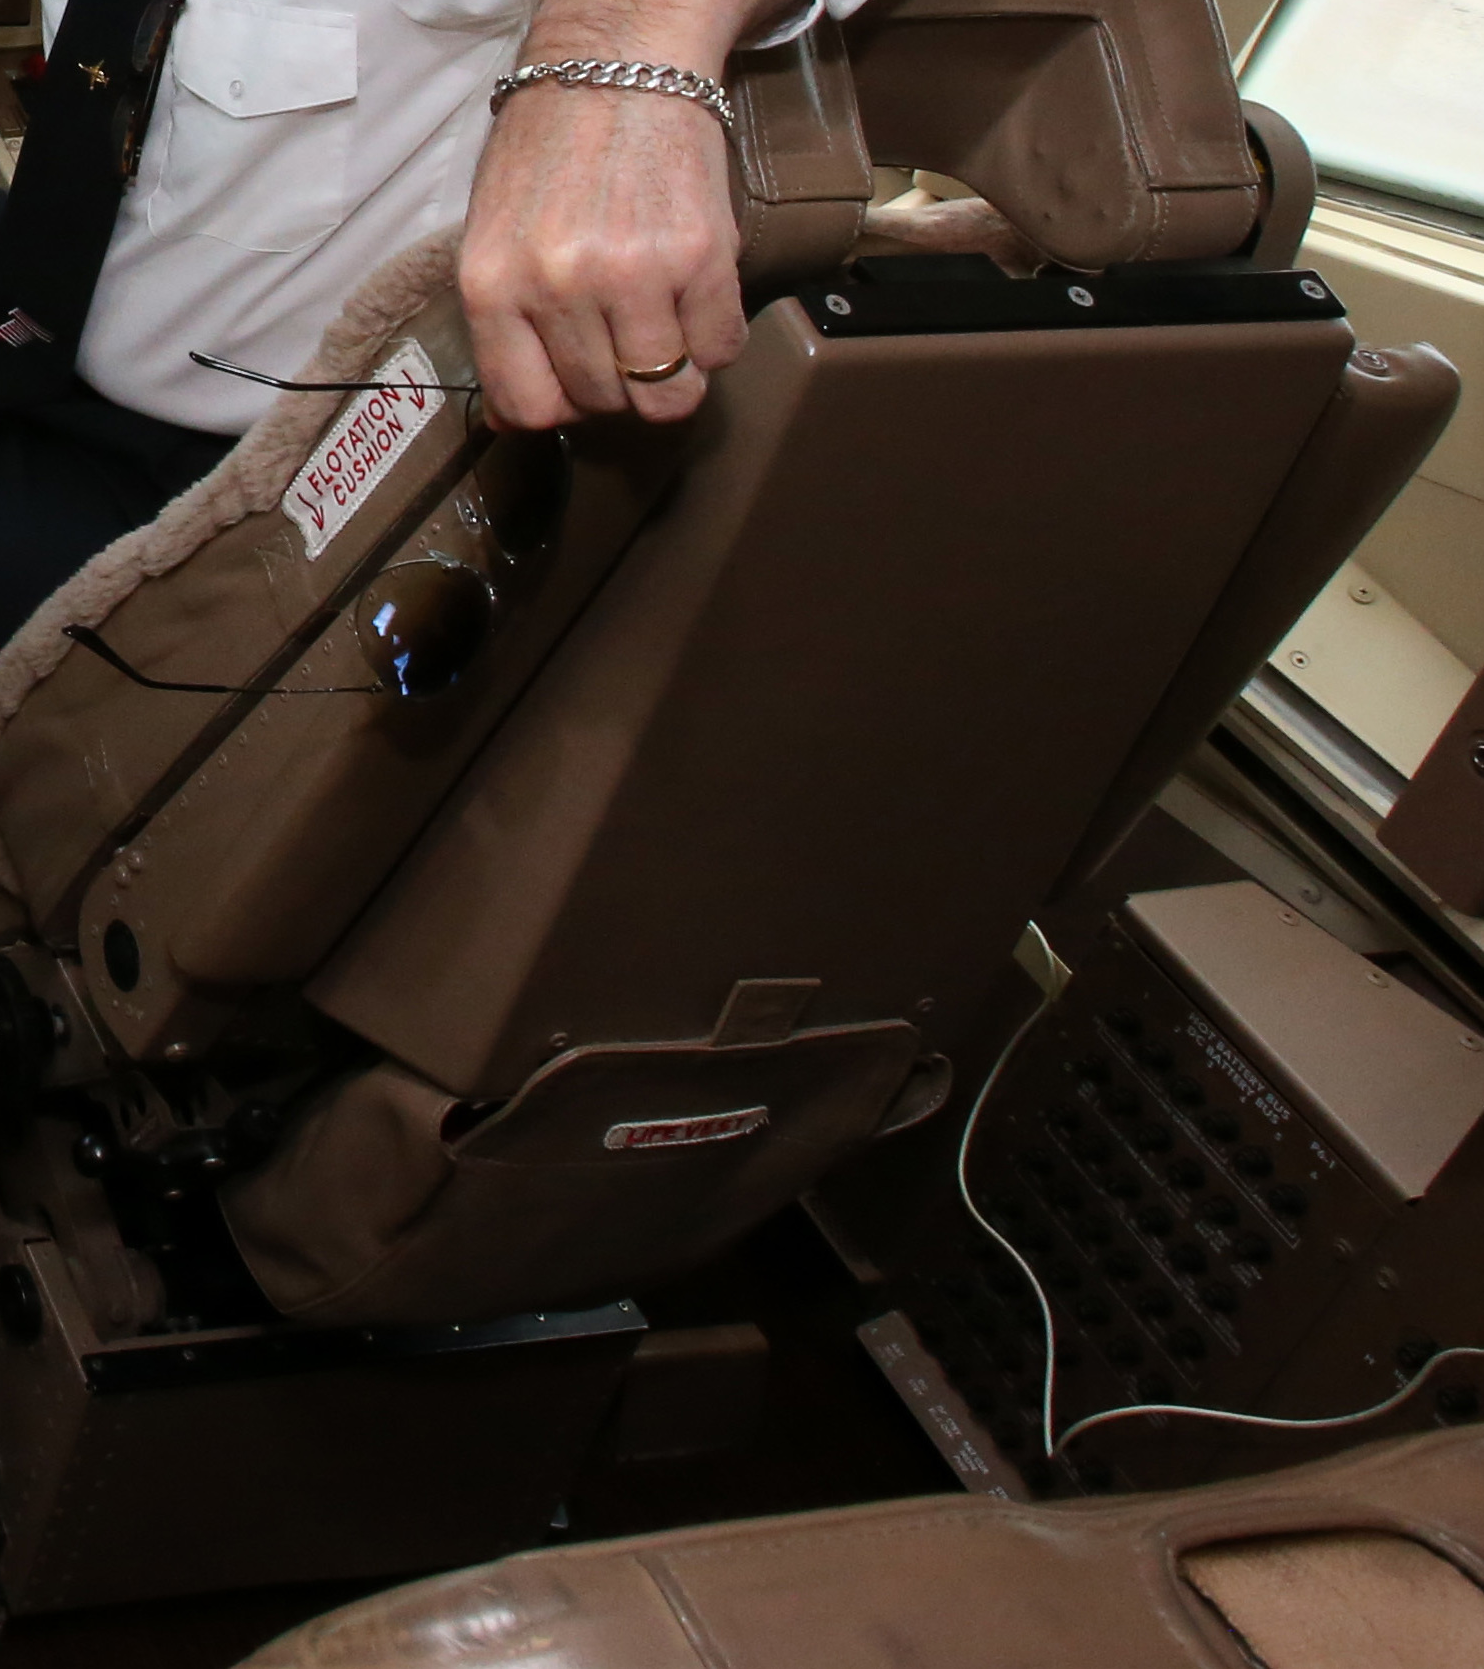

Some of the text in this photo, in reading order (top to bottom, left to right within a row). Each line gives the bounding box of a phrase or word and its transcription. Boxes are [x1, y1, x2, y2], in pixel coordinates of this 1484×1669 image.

[307, 382, 402, 496] FLOTATION
[333, 413, 404, 506] CUSHION
[1206, 1045, 1255, 1096] BATTERY
[1216, 1040, 1265, 1091] BATTERY
[1265, 1092, 1290, 1120] BUS
